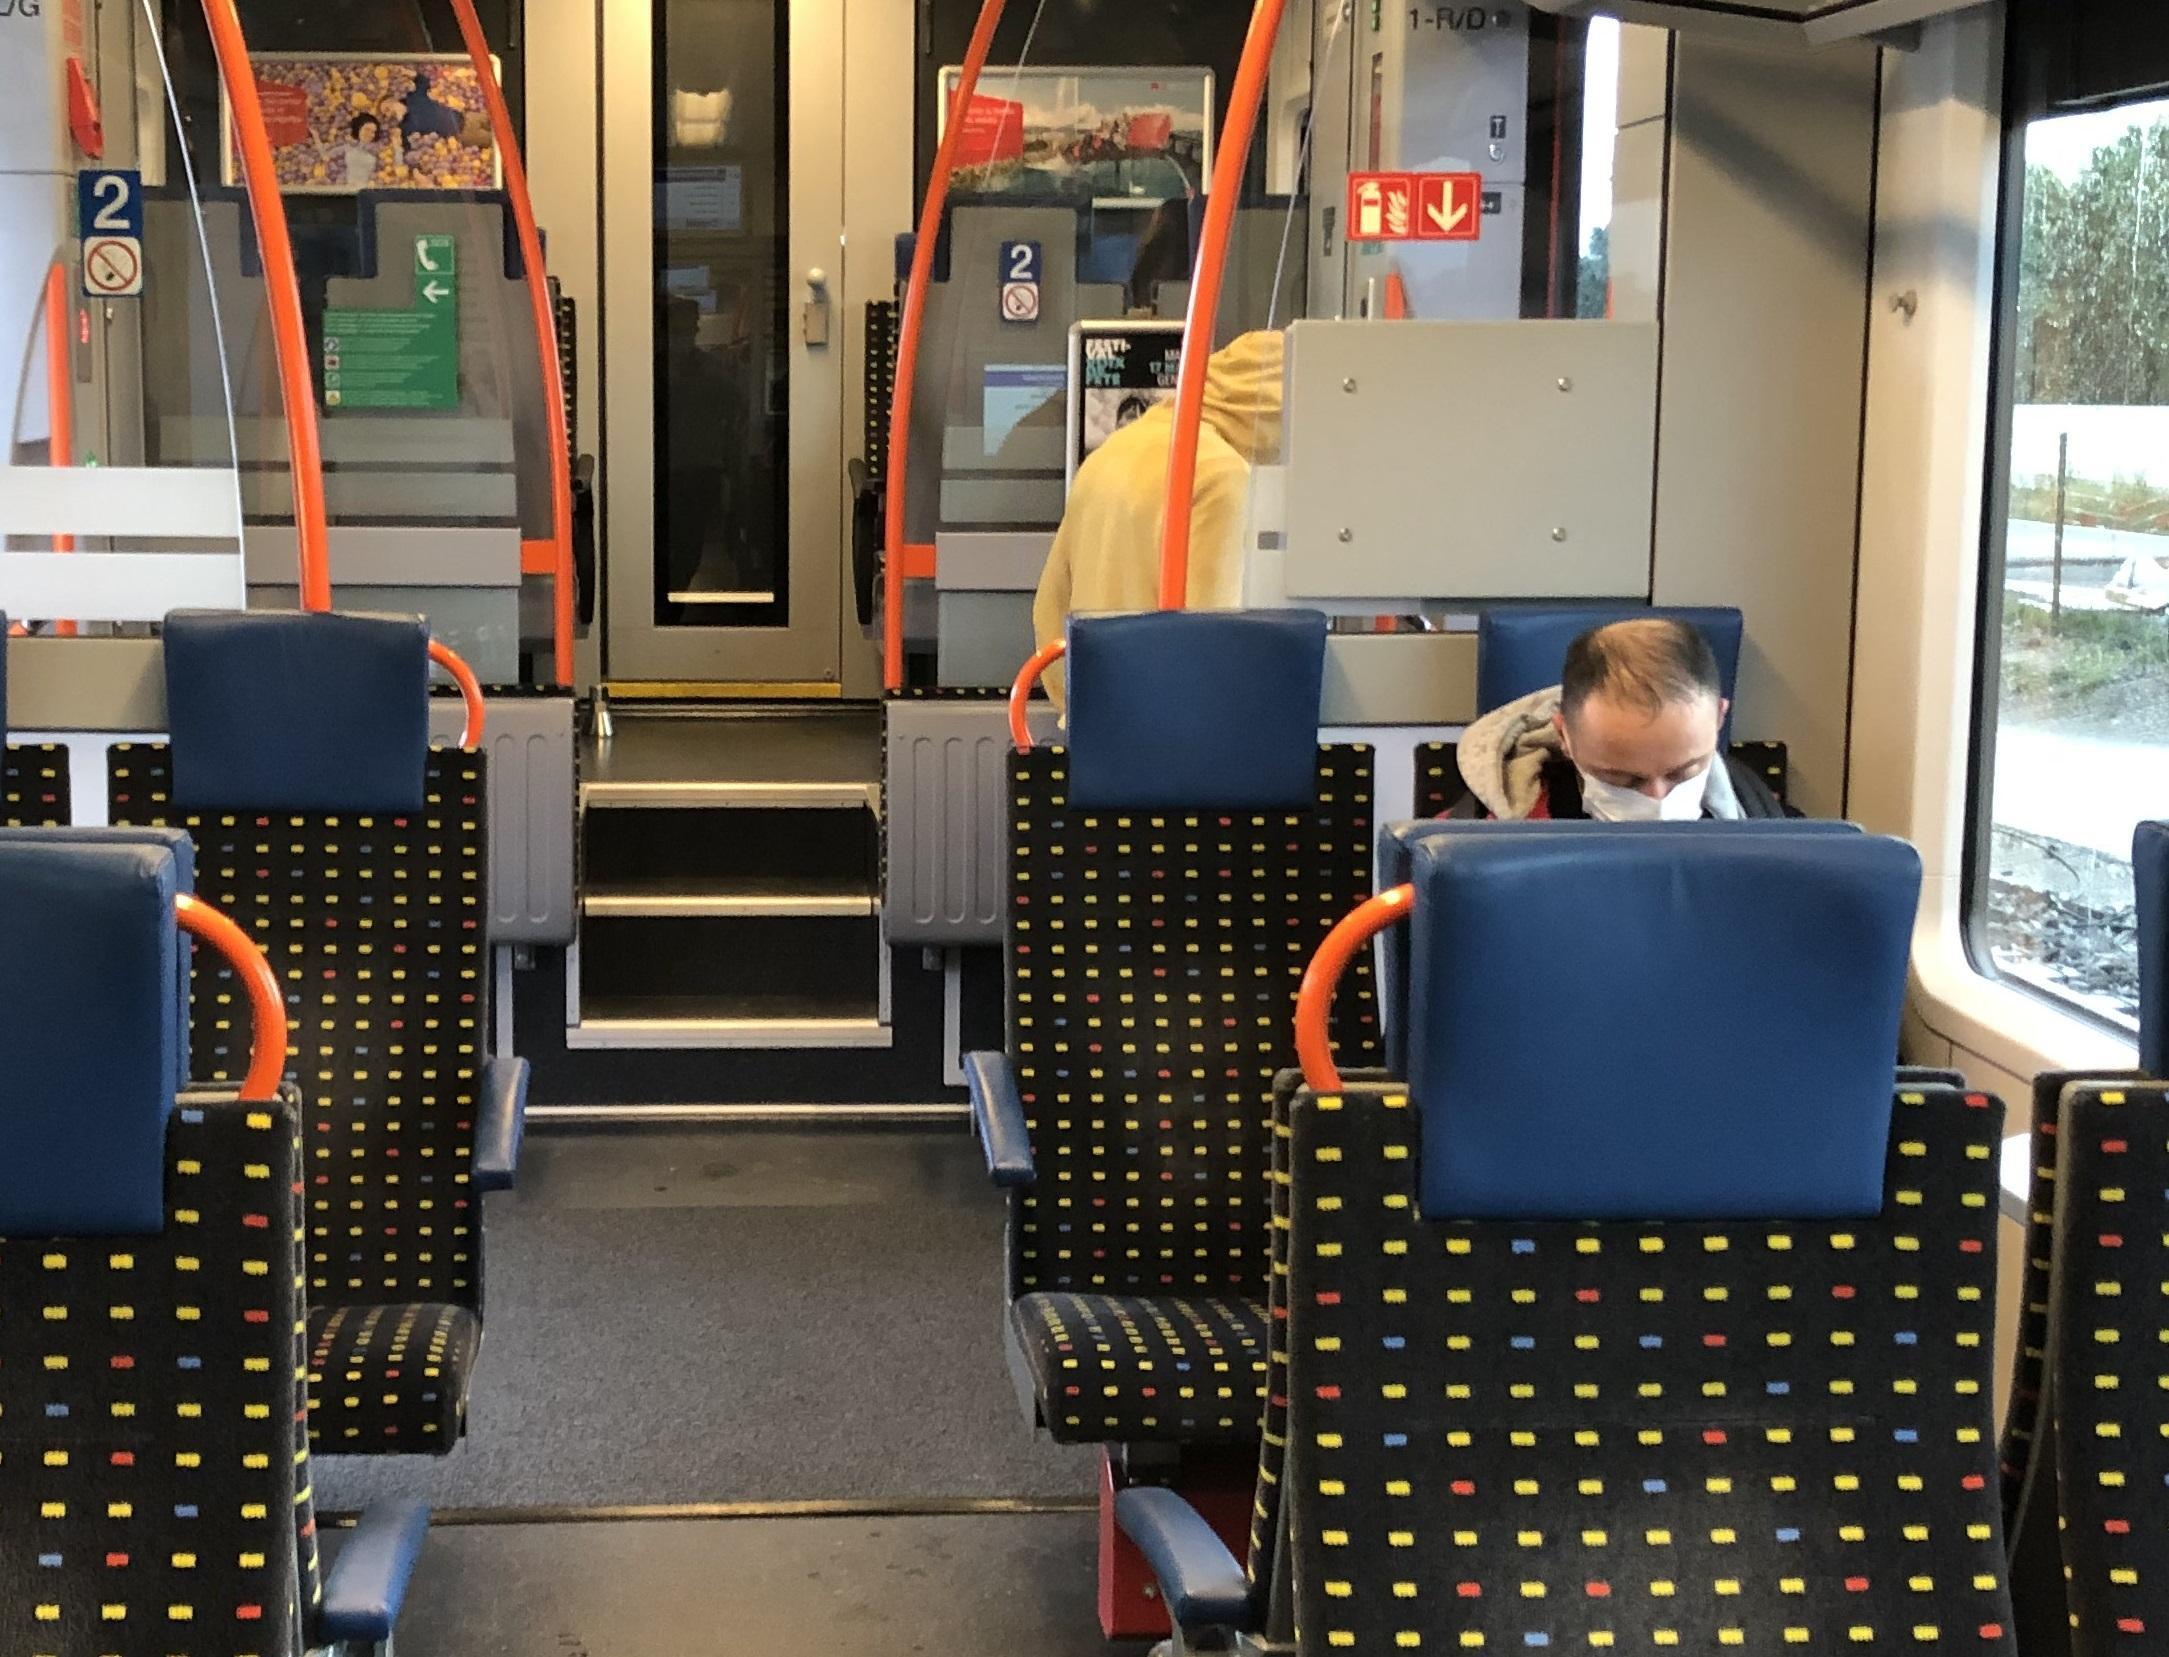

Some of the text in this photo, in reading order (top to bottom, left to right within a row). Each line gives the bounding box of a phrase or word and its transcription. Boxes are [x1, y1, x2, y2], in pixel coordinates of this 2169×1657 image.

[1410, 7, 1486, 31] 1-R/D
[93, 175, 131, 230] 2
[1010, 244, 1033, 280] 2
